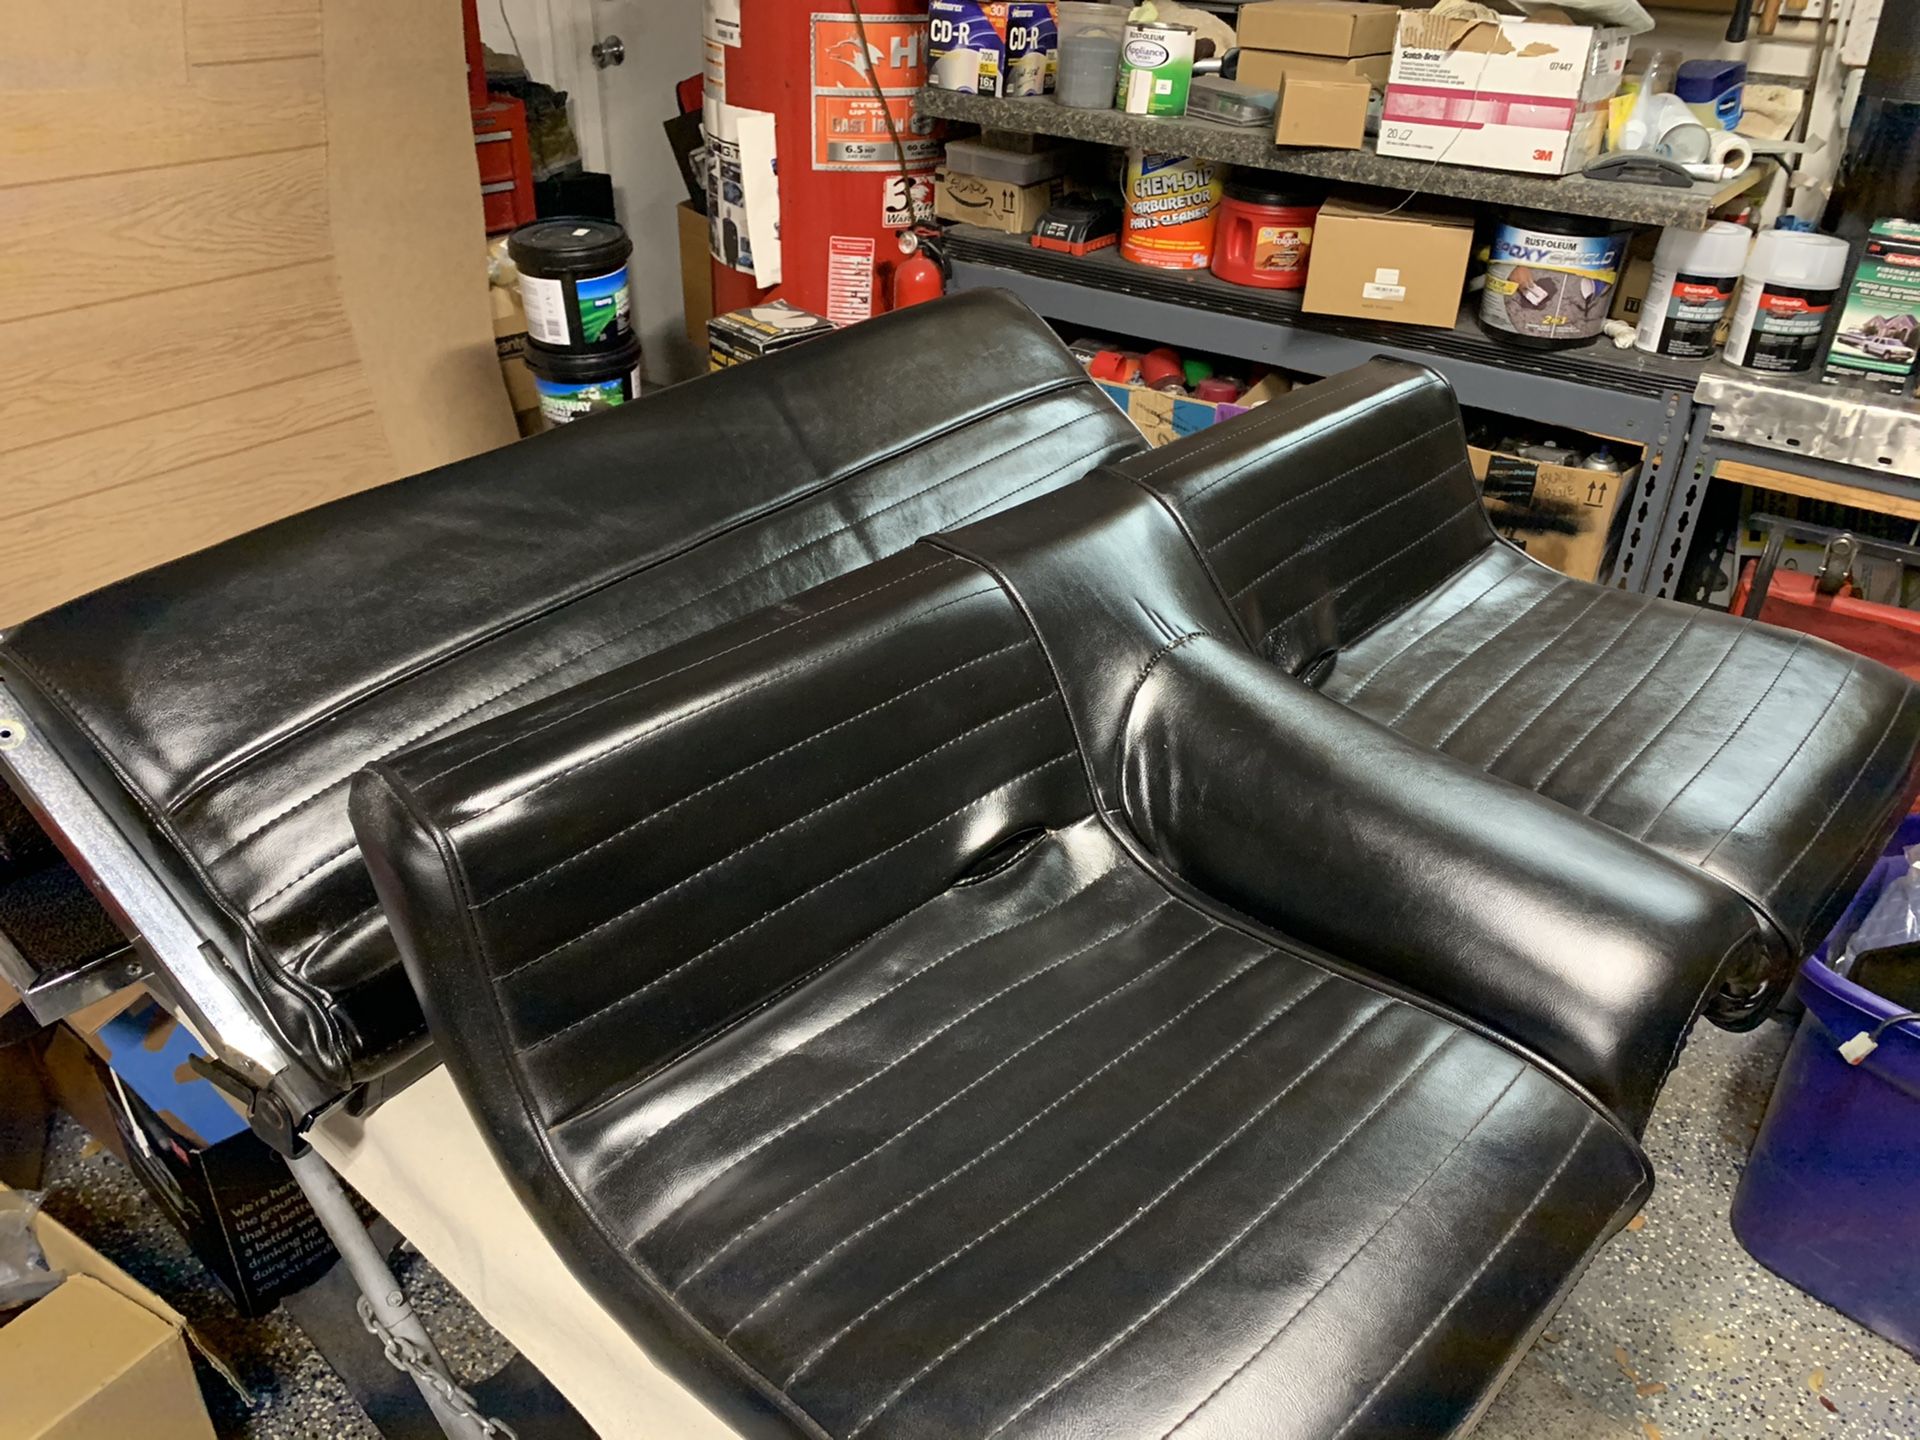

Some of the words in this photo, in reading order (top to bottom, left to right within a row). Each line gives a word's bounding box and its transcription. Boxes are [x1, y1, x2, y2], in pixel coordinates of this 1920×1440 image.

[930, 19, 970, 46] CD-R
[1009, 26, 1039, 51] CD-R
[1127, 45, 1165, 58] Appliance
[1401, 50, 1441, 61] Scotch-Brite
[1549, 60, 1574, 72] 07447
[832, 118, 867, 134] CAST
[872, 116, 904, 134] IRN
[1386, 128, 1399, 139] 20
[845, 144, 864, 154] 6.5
[1532, 149, 1553, 162] 3M
[1133, 166, 1214, 198] CHEM-DIP
[1131, 189, 1211, 214] CARBURETOR
[1130, 217, 1159, 230] PARTS
[1160, 206, 1210, 227] CLEANER
[1524, 236, 1578, 251] RUST-OLEUM
[235, 1215, 259, 1231] the
[260, 1190, 304, 1223] ground
[239, 1225, 268, 1245] that
[269, 1220, 279, 1230] a
[244, 1248, 253, 1258] a
[254, 1226, 294, 1252] better
[248, 1235, 302, 1270] drinking
[302, 1226, 320, 1241] up
[252, 1258, 288, 1282] doing
[289, 1246, 304, 1262] all
[304, 1236, 327, 1252] the
[256, 1277, 280, 1297] you
